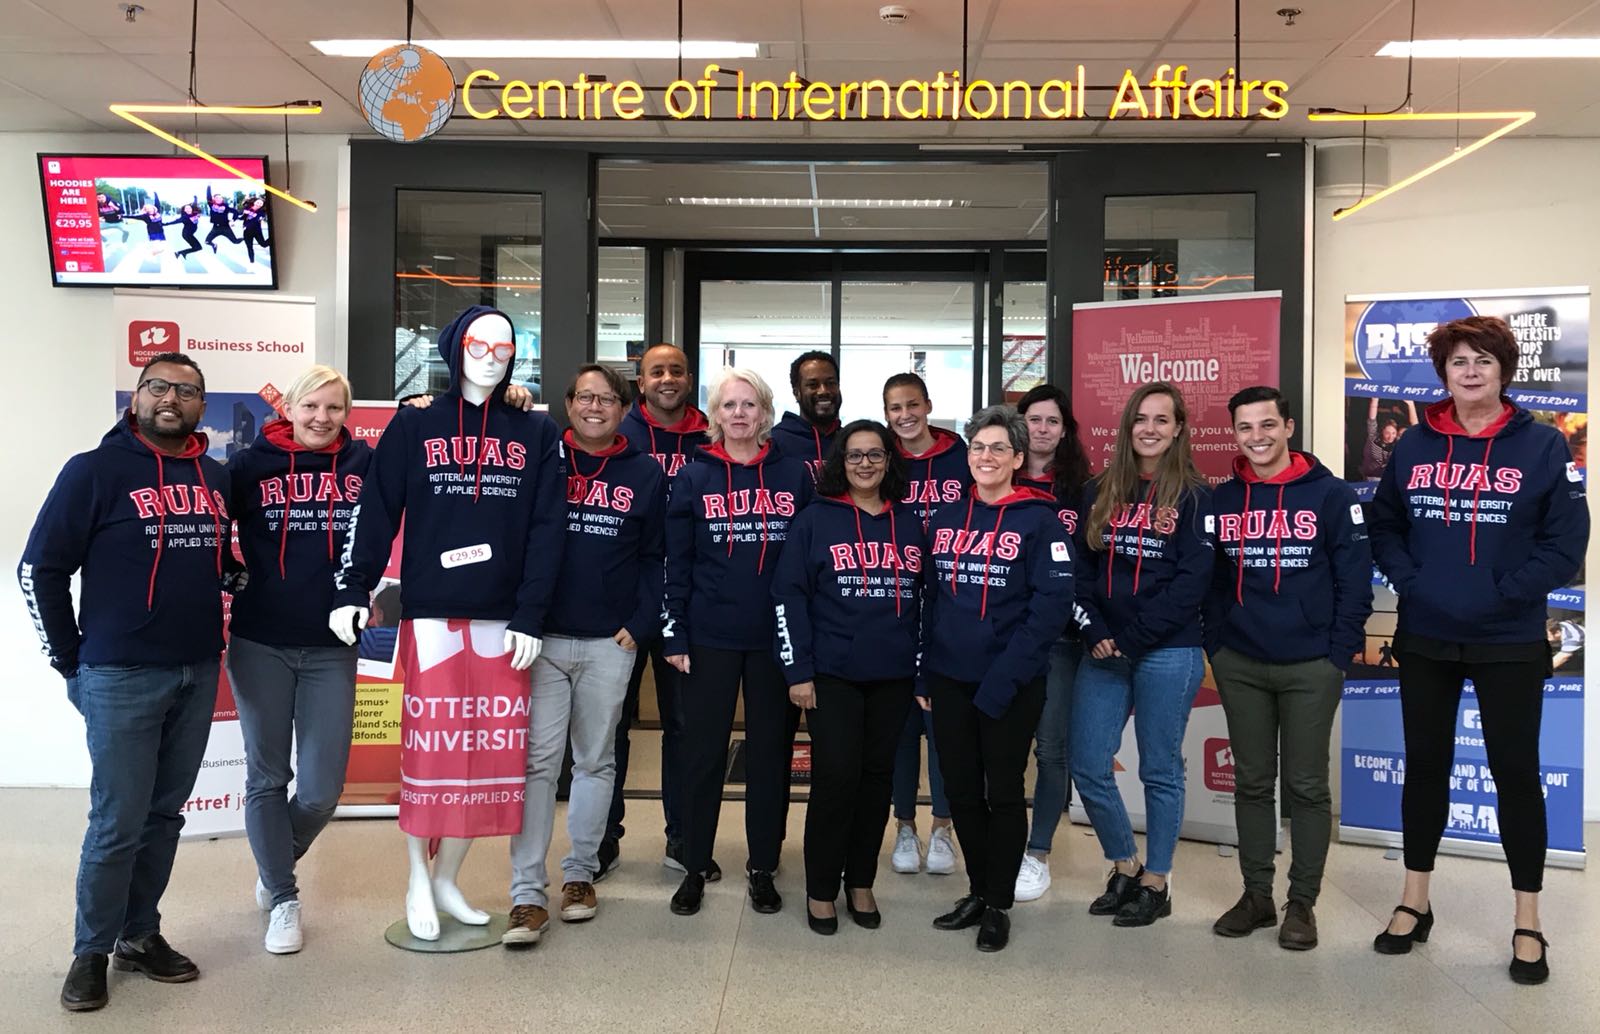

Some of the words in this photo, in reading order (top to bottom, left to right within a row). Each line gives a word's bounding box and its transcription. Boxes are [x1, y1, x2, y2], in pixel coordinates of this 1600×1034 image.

[462, 69, 645, 120] Centre
[664, 64, 720, 120] of
[736, 64, 1086, 121] International
[1109, 64, 1290, 120] Affairs
[50, 180, 93, 188] HOODIES
[62, 188, 81, 196] ARE
[60, 197, 87, 205] HERE!
[55, 219, 93, 228] €29,95
[1509, 313, 1548, 327] WHERE
[187, 339, 253, 352] Business
[257, 341, 304, 353] School
[1516, 341, 1543, 355] TOPS
[1119, 353, 1220, 384] Welcome
[1533, 367, 1562, 382] OVER
[1353, 383, 1379, 393] MAKE
[1382, 385, 1400, 394] THE
[1403, 387, 1429, 396] MOST
[1516, 394, 1578, 406] ROTTERDAM
[355, 427, 384, 437] Extr
[1091, 427, 1108, 436] We
[1200, 427, 1220, 437] you
[424, 436, 527, 470] RUAS
[1191, 443, 1239, 451] rements
[1407, 461, 1523, 494] RUAS
[259, 472, 363, 507] RUAS
[434, 486, 443, 494] OF
[482, 486, 517, 497] SCIENCES
[703, 488, 795, 519] RUAS
[582, 512, 625, 526] UNIVERSITY
[1425, 509, 1461, 521] APPLED
[269, 522, 279, 531] OF
[584, 524, 619, 537] SCIENCES
[1219, 510, 1318, 542] RUAS
[168, 538, 201, 548] APPLIED
[713, 535, 723, 543] OF
[932, 528, 1022, 561] RUAS
[830, 542, 922, 574] RUAS
[841, 588, 851, 597] OF
[1344, 686, 1371, 695] SPORT
[1375, 686, 1400, 694] EVENT
[1559, 684, 1583, 692] MORE
[354, 709, 383, 719] plorer
[352, 720, 380, 728] olland
[405, 728, 530, 752] UNIVERSIT
[1355, 755, 1394, 770] BECOME
[1454, 764, 1476, 778] AND
[1546, 773, 1569, 787] OUT
[1373, 770, 1387, 783] ON
[1467, 779, 1479, 792] OF
[442, 793, 461, 805] OF
[462, 790, 510, 806] APPLIED
